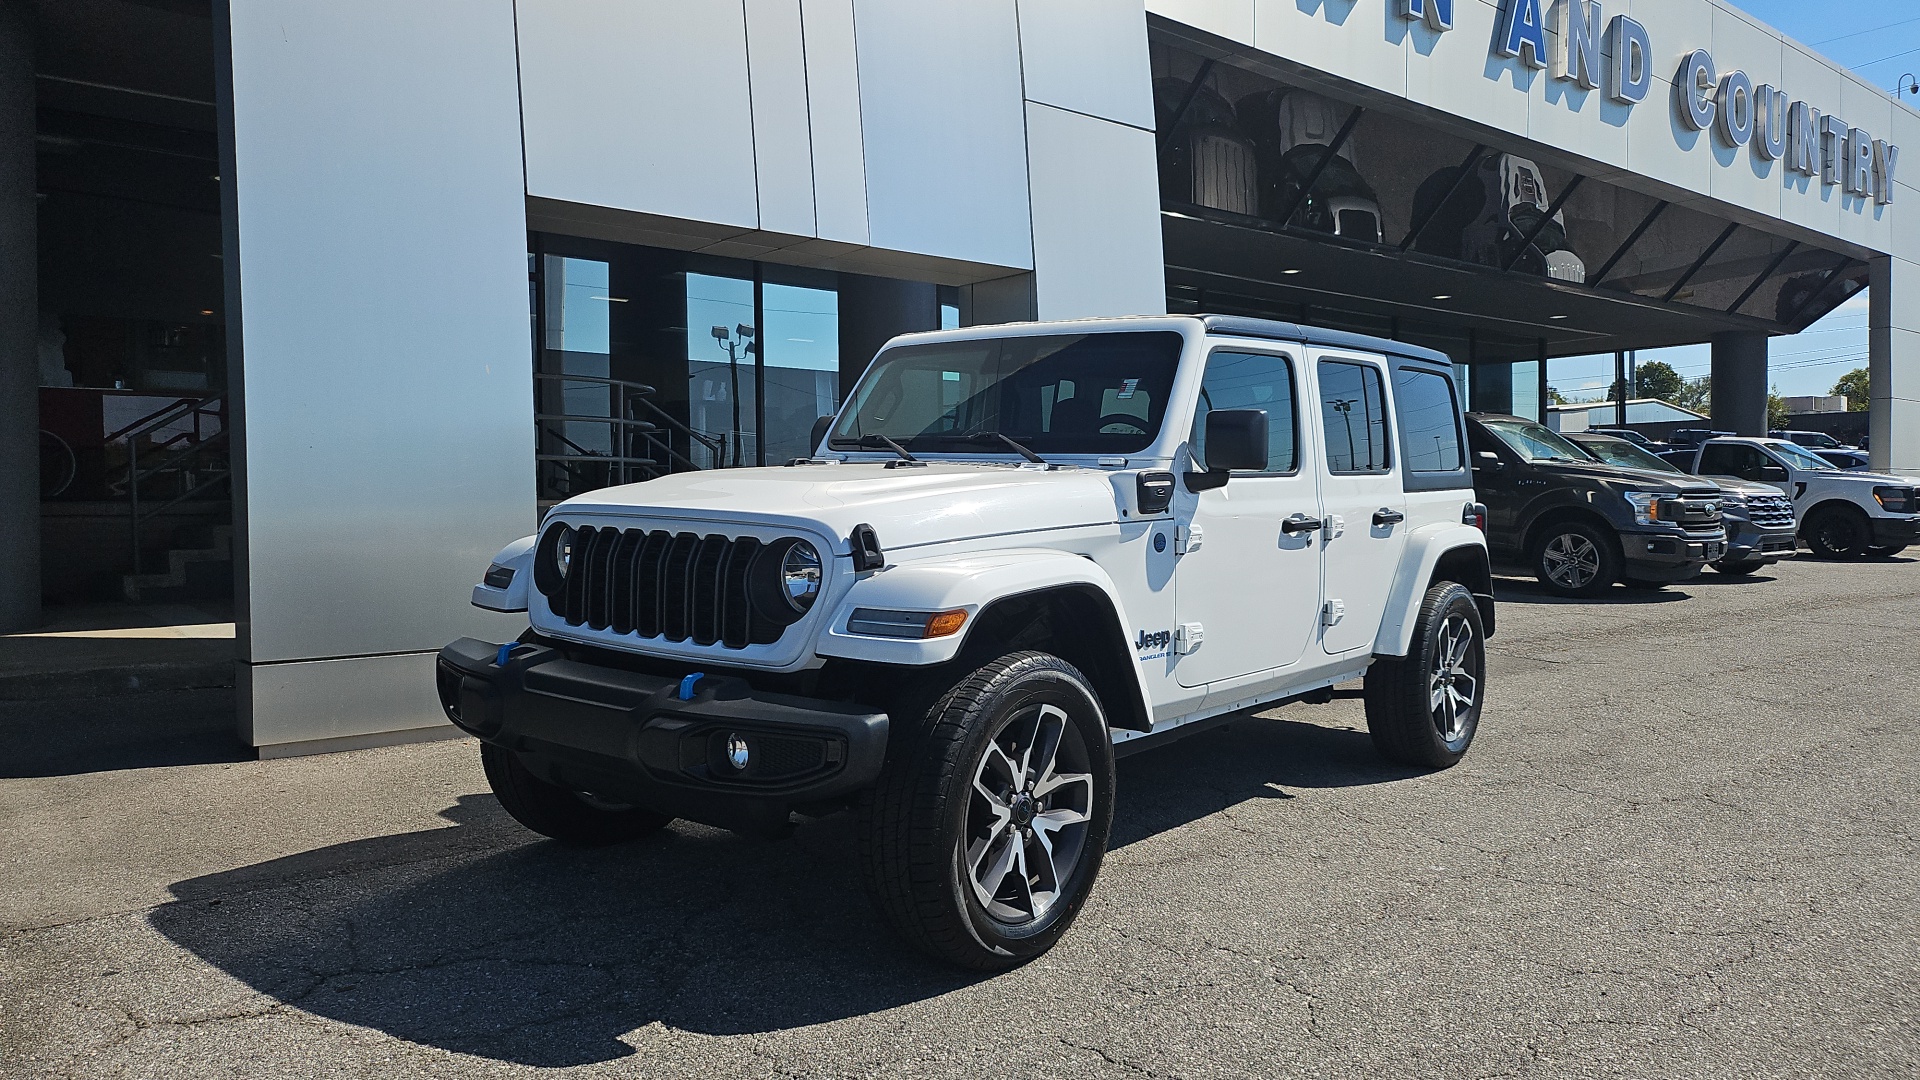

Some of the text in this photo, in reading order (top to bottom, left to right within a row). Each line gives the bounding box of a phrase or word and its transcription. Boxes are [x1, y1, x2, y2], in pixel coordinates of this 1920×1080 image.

[1498, 0, 1899, 205] AND COUNTRY
[1135, 629, 1170, 650] Jeep
